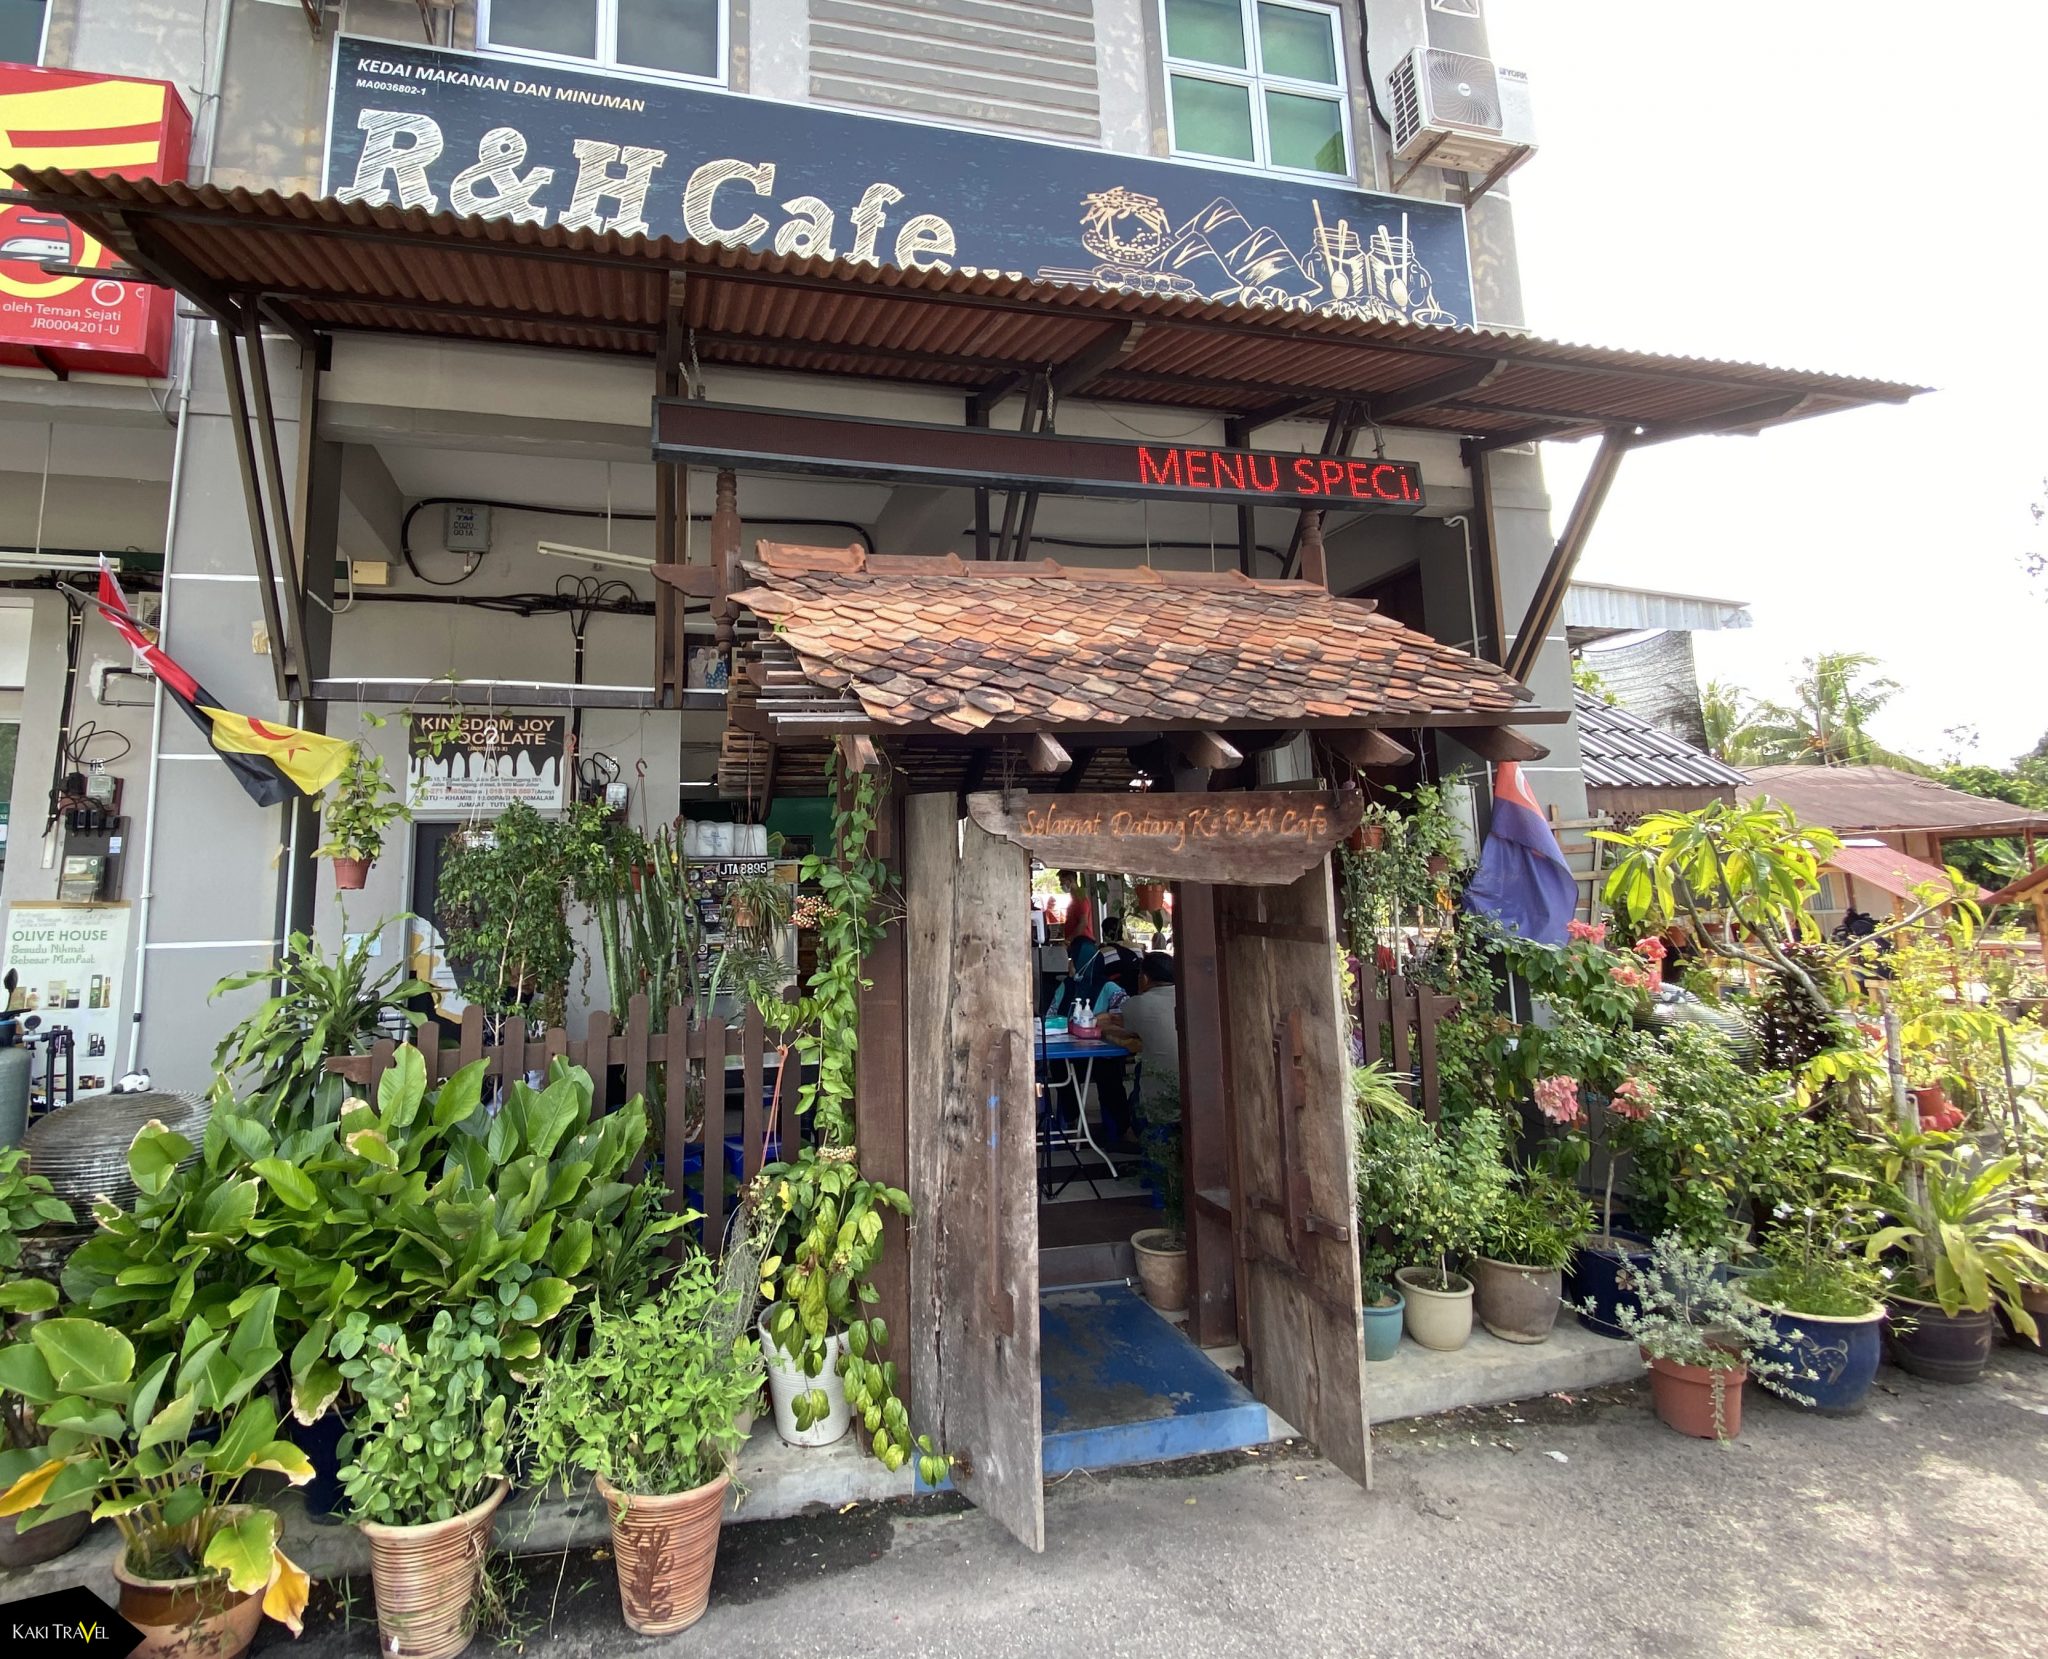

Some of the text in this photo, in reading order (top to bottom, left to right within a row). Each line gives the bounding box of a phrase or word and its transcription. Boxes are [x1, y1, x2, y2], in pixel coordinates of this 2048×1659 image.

[356, 78, 427, 96] MA0036802-1
[357, 58, 646, 112] KEDAI MAKANAN DAN MINUMAN
[336, 109, 668, 236] R&H
[3, 302, 121, 321] oleh Teman Sejati
[31, 317, 120, 335] JR0004201-U
[1138, 445, 1279, 492] MENU
[421, 717, 555, 732] KINGDOM JOY
[1020, 803, 1102, 836] Selamat
[1111, 810, 1187, 851] Datang
[1224, 807, 1276, 838] R&H
[1281, 804, 1328, 844] Cafe
[720, 862, 767, 875] JTA 8895
[12, 930, 108, 941] OLIVE HOUSE
[50, 943, 86, 954] Nikmat
[52, 953, 96, 964] Manfaat
